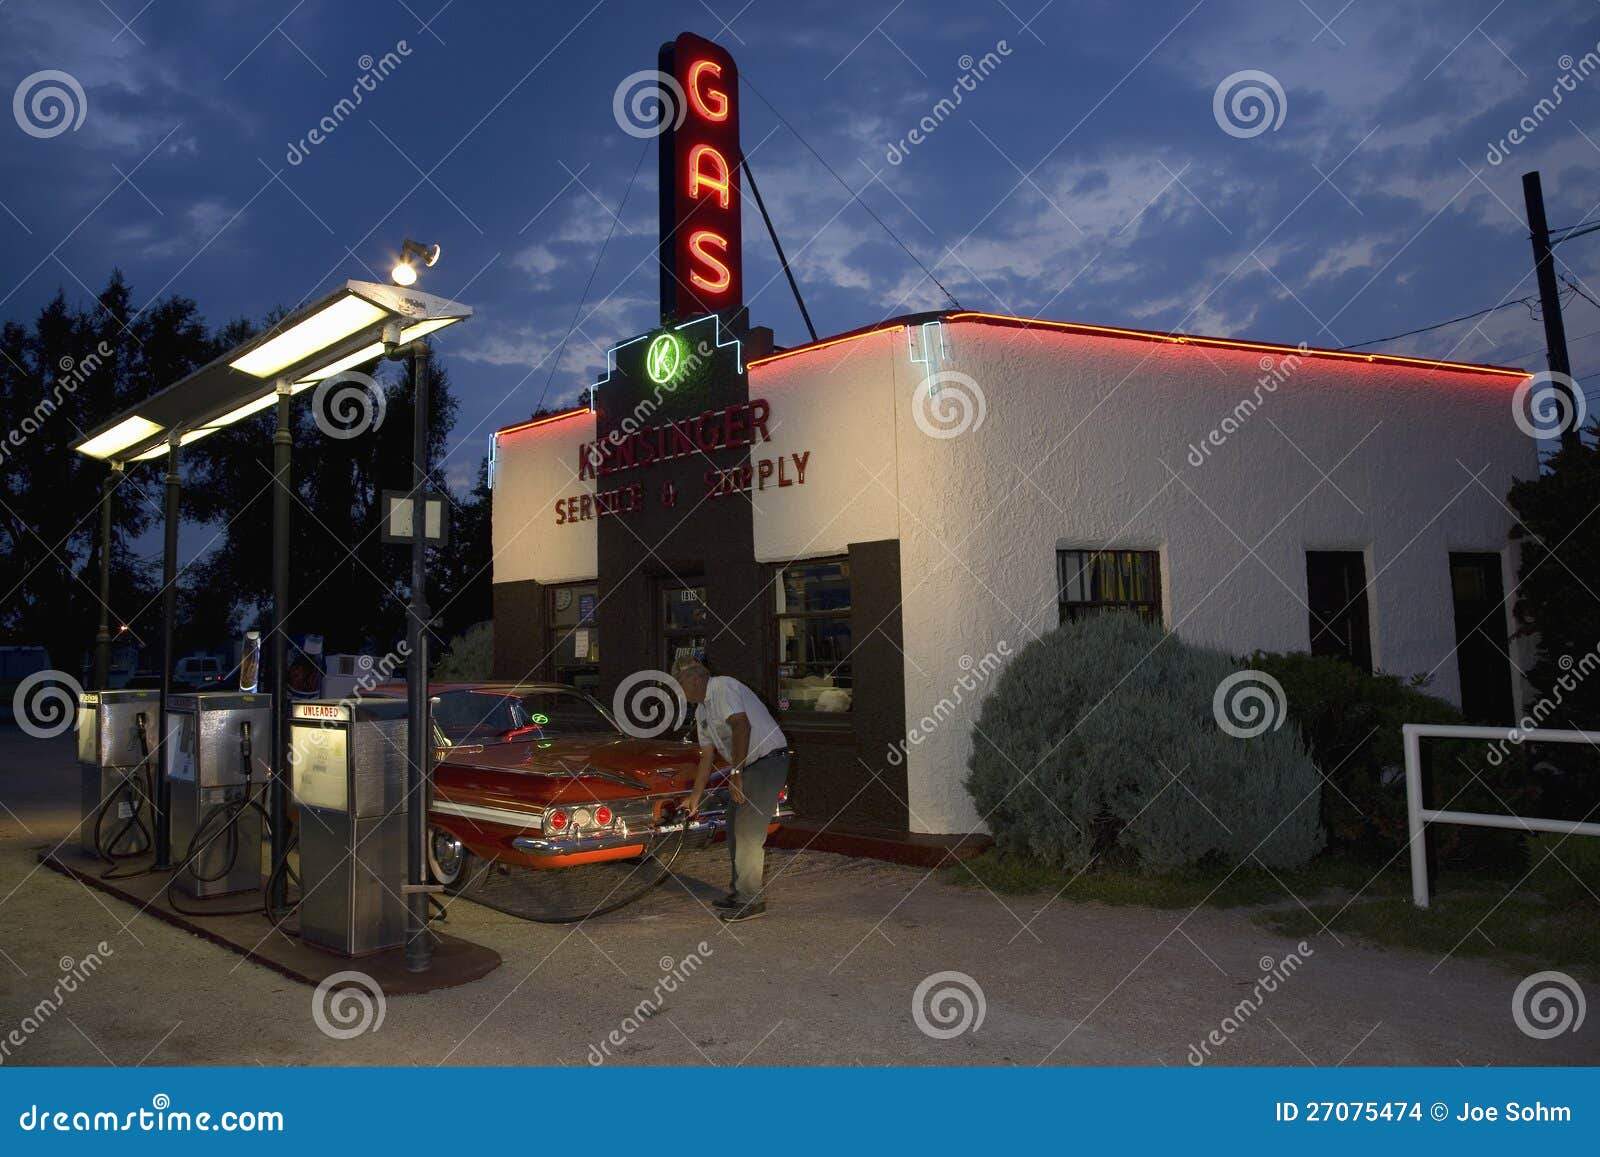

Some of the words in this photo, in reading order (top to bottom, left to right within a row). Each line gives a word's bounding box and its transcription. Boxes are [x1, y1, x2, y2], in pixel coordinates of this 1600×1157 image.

[688, 59, 730, 293] GAS
[578, 398, 772, 481] KENSINGER
[555, 481, 642, 524] SERVICE
[703, 451, 811, 498] SUPPLY
[303, 705, 339, 718] UNLEADED
